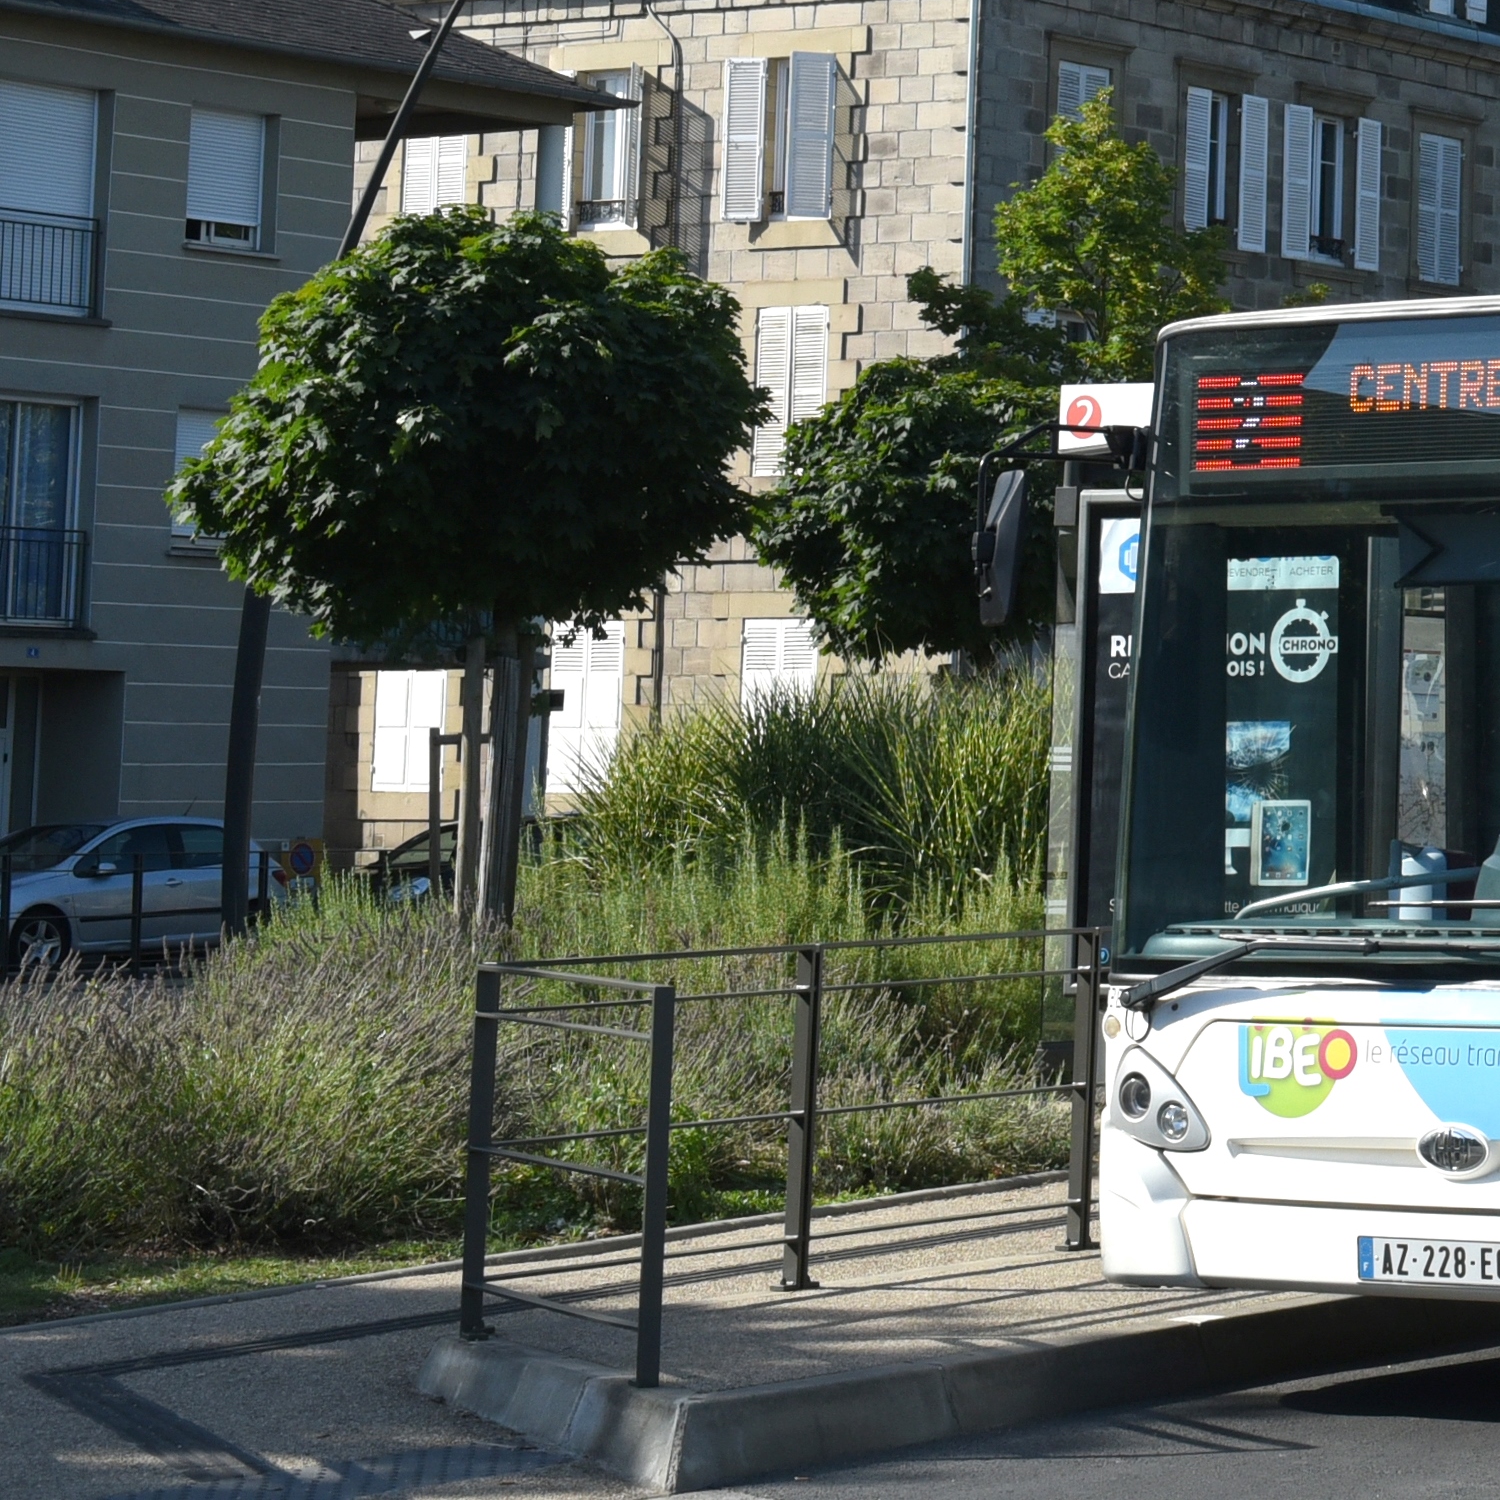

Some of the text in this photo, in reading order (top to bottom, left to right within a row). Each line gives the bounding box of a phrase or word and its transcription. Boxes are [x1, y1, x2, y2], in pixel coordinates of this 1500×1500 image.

[1075, 400, 1094, 427] 2
[1228, 566, 1334, 578] EVENDRE ACHETER
[1283, 638, 1336, 651] CHRONO
[1366, 1039, 1382, 1063] le
[1390, 1038, 1460, 1066] réseau
[1363, 1262, 1369, 1272] F
